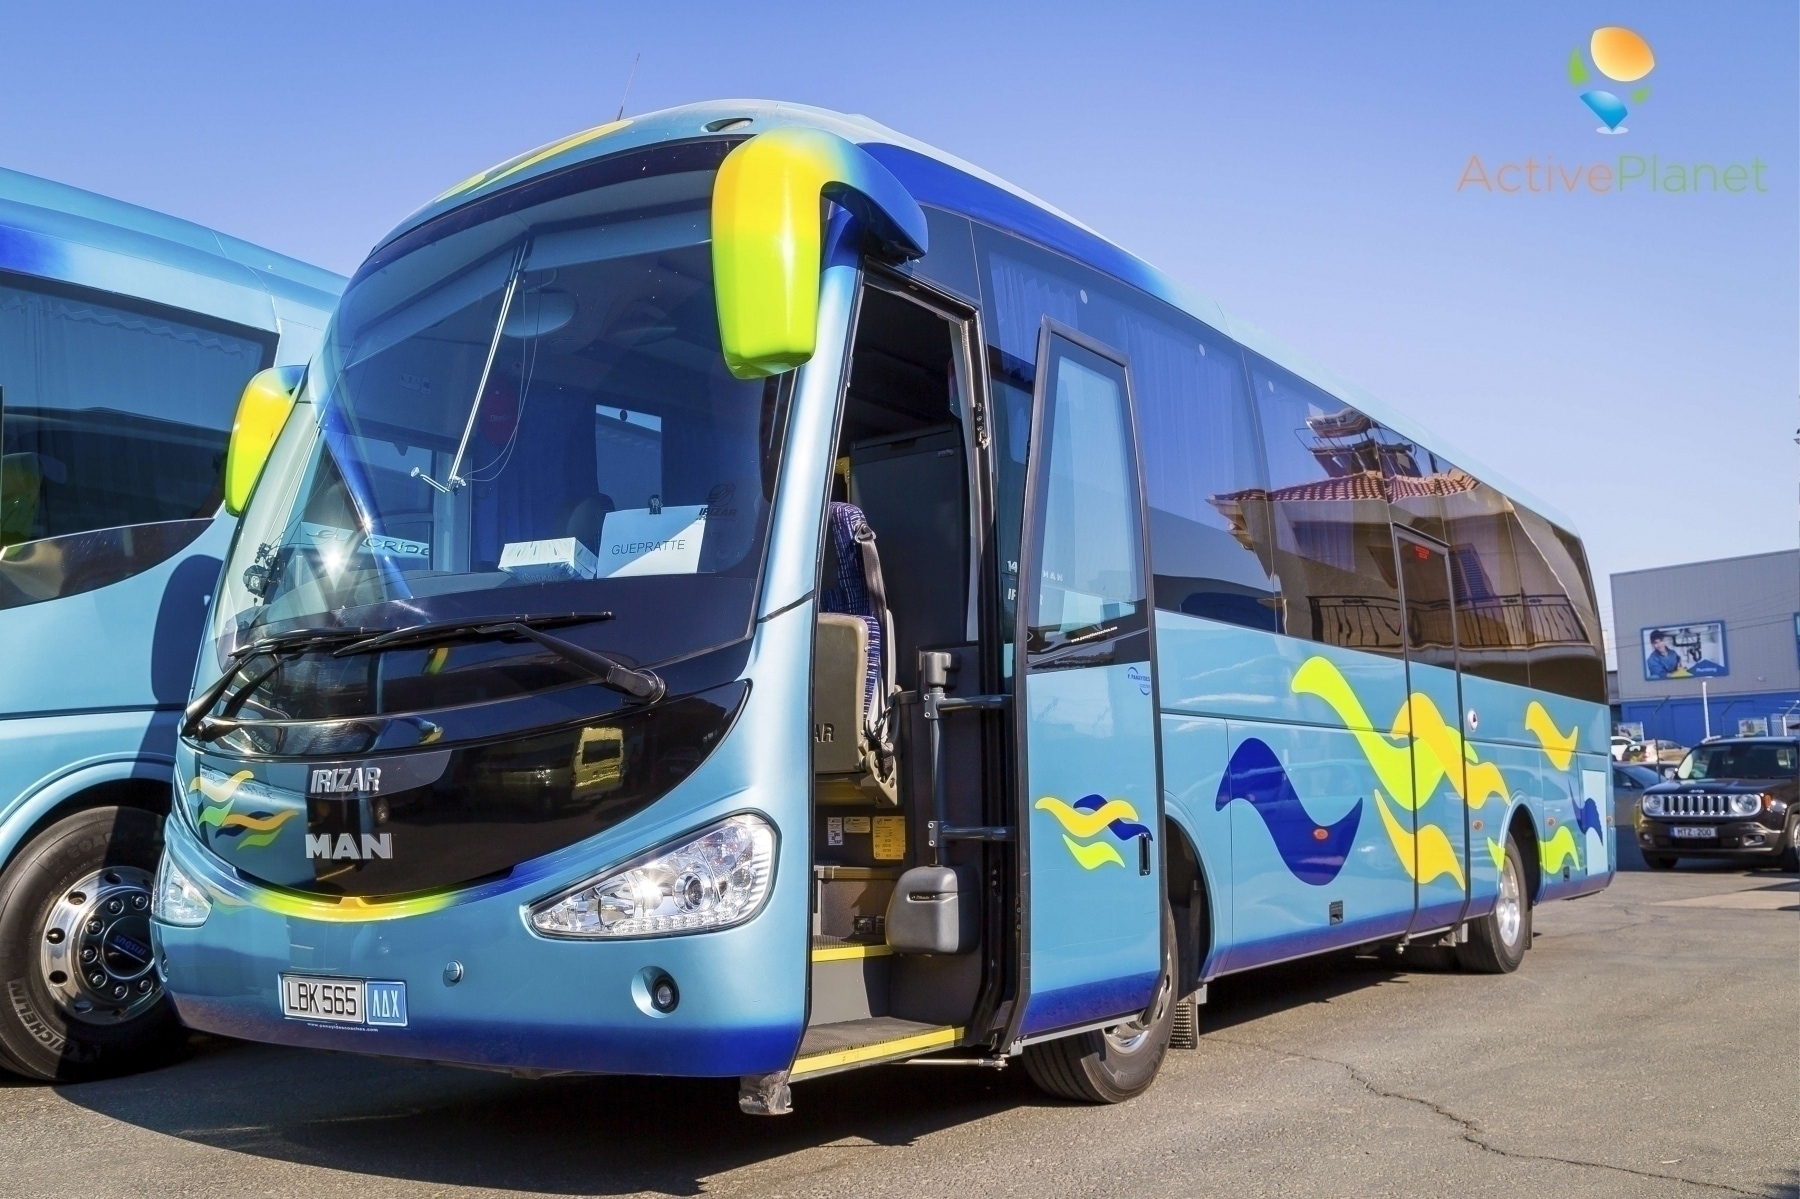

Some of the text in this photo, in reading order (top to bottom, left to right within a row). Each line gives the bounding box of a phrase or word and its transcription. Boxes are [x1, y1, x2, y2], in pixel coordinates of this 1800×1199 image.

[611, 539, 686, 555] GUEPRATTE
[310, 767, 382, 794] IRIZAR
[305, 833, 393, 860] MAN
[287, 981, 357, 1016] LBK 565
